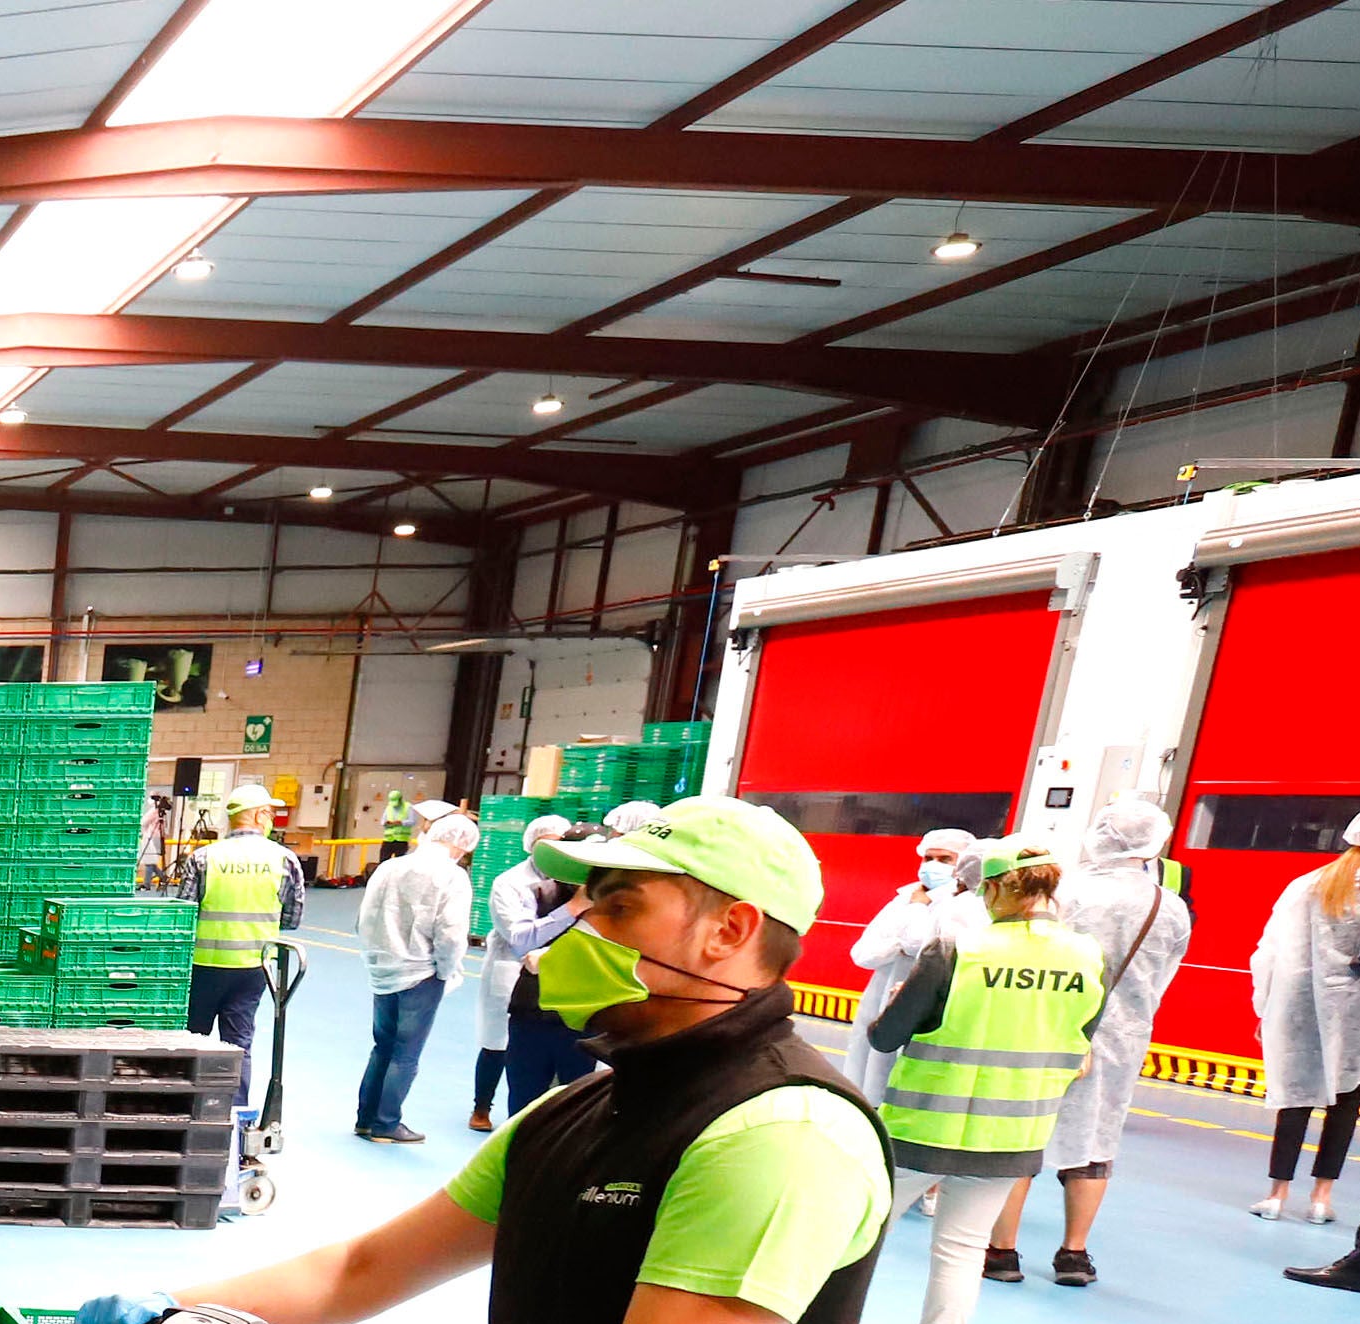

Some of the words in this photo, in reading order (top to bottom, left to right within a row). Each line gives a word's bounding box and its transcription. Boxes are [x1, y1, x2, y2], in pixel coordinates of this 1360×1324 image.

[218, 863, 272, 875] VISITA
[982, 966, 1085, 993] VISITA
[578, 1185, 642, 1207] illenium
